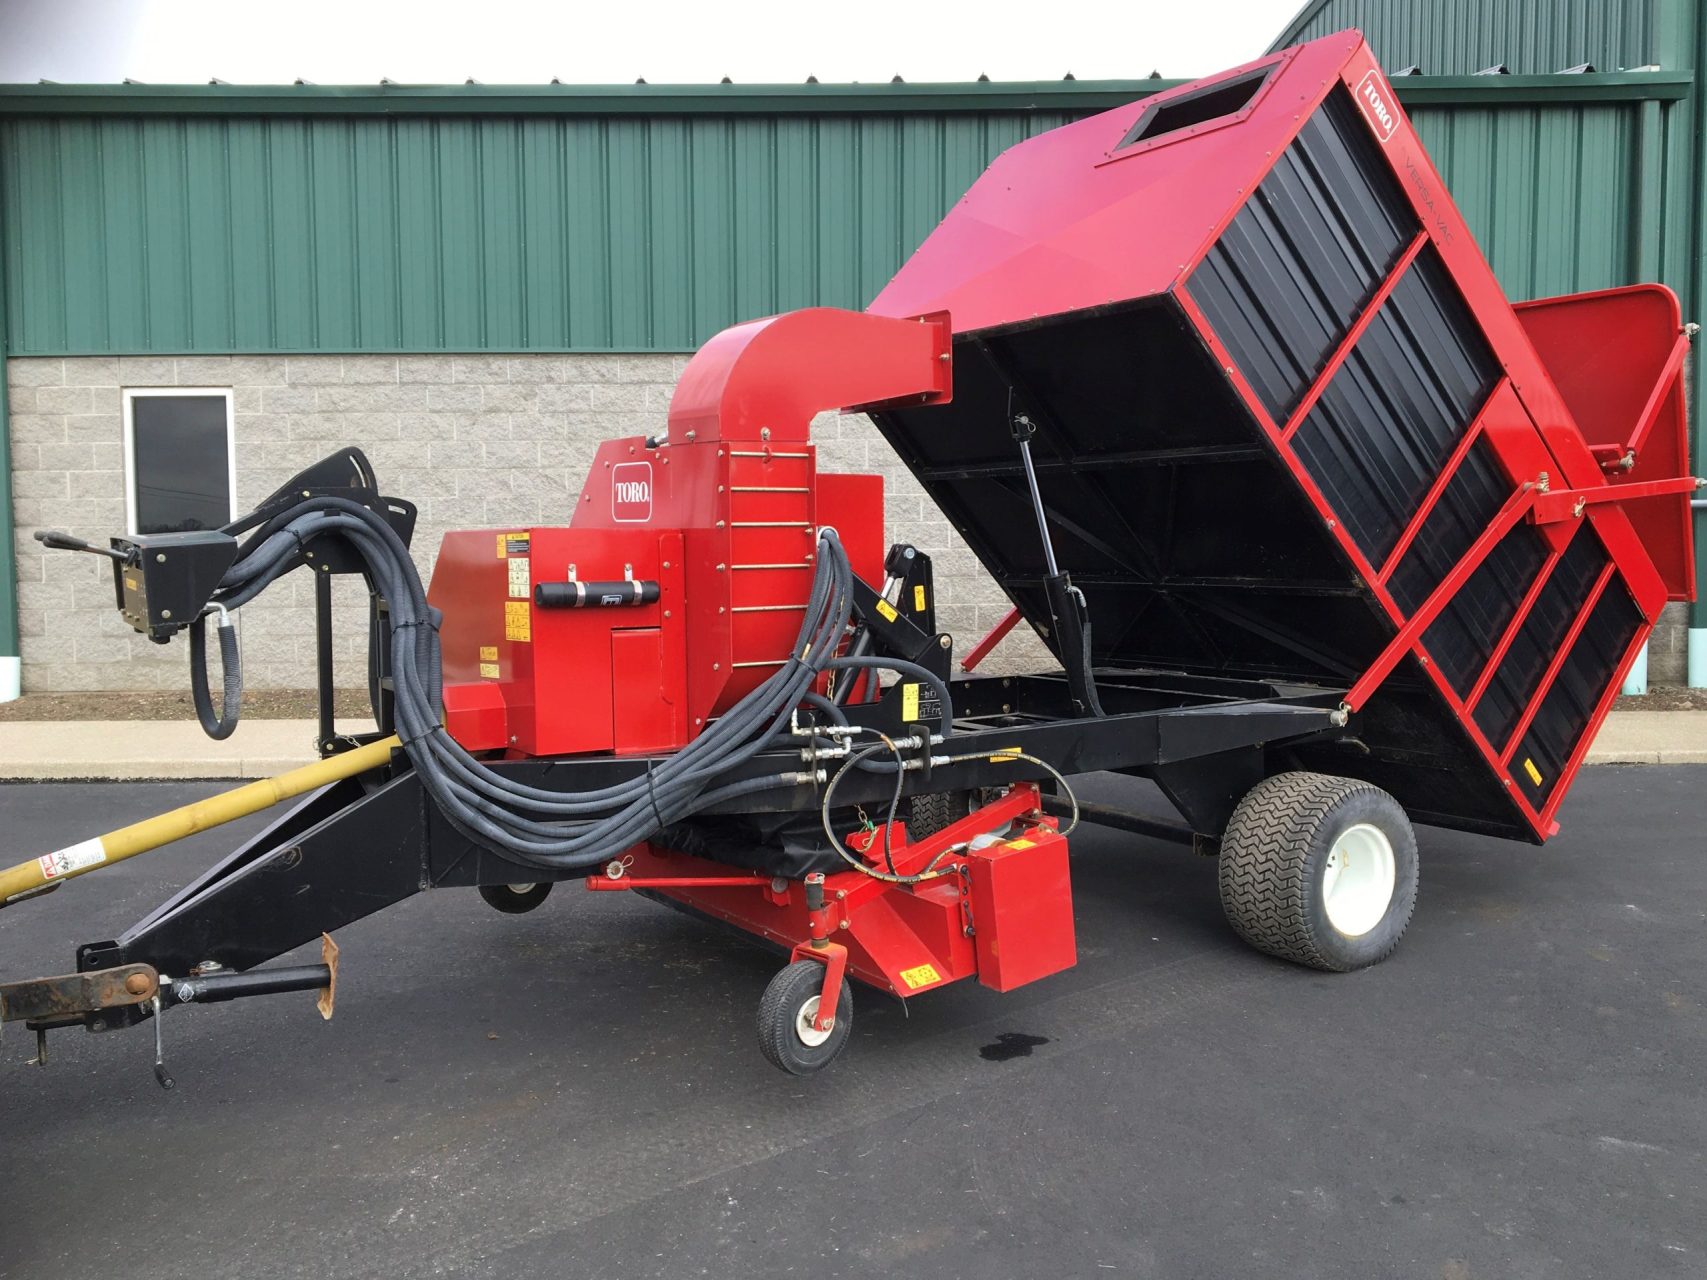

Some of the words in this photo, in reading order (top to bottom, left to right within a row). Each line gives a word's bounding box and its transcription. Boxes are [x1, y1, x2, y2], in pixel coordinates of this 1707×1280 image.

[1363, 80, 1393, 131] TORO
[1404, 156, 1453, 244] VERSA-VAC
[615, 481, 649, 503] TORO
